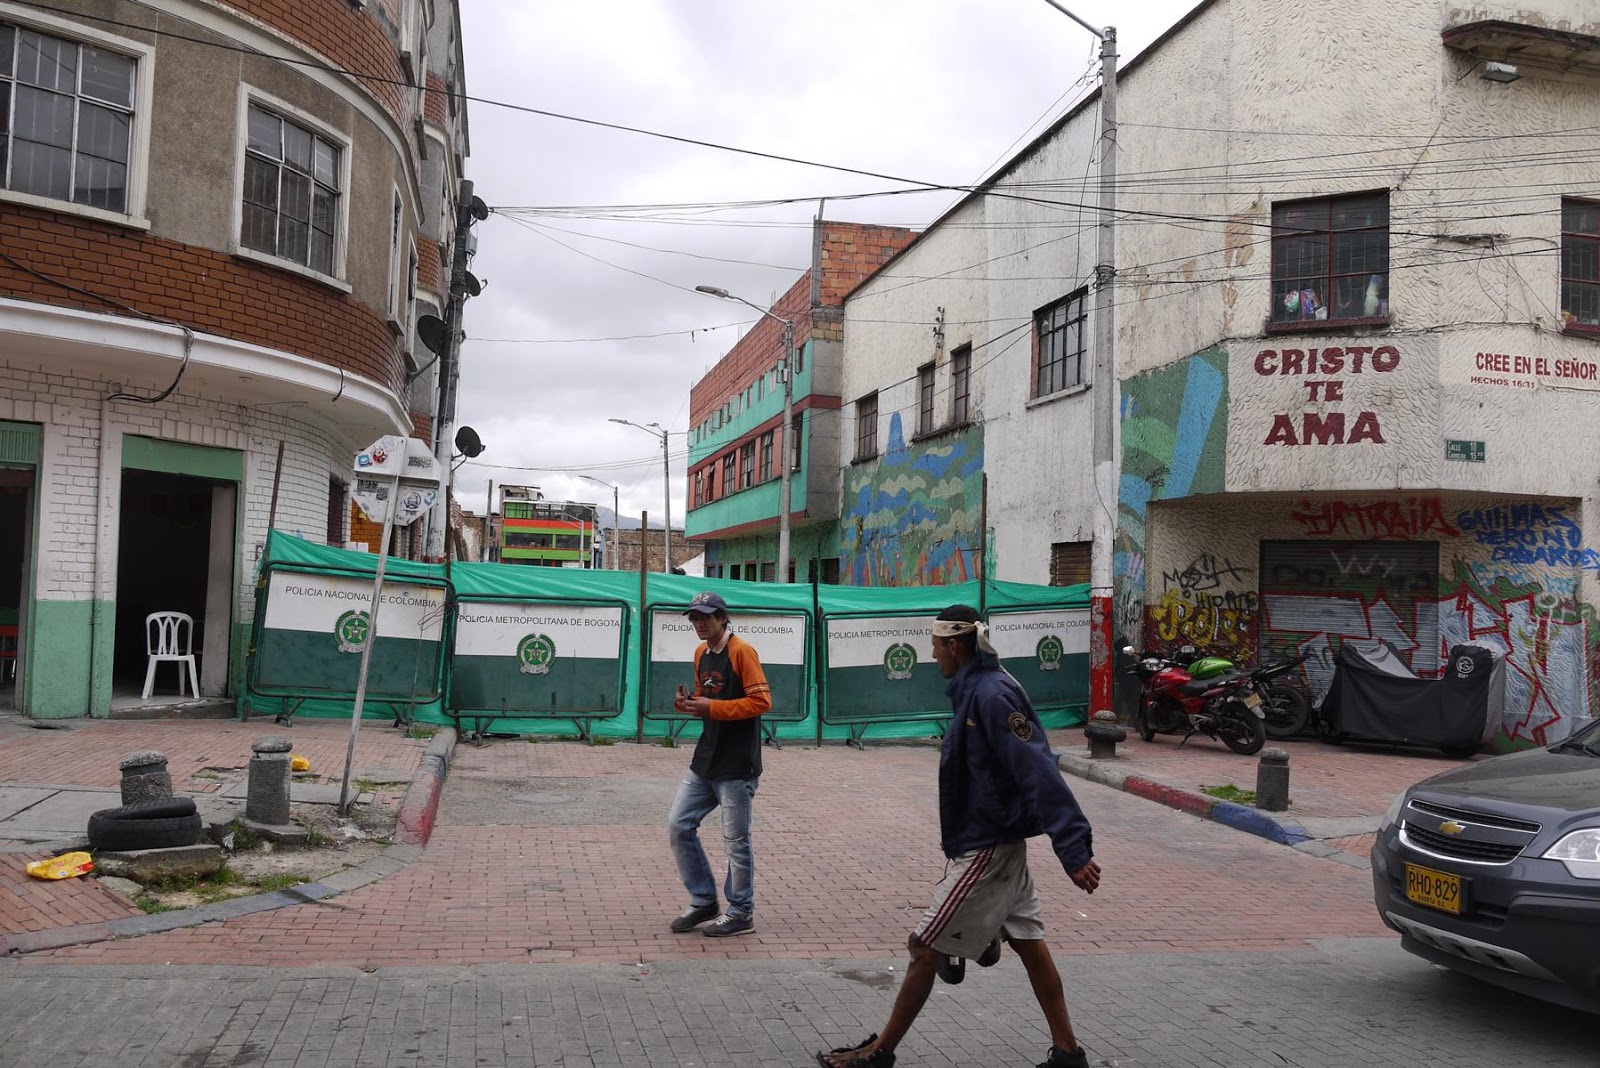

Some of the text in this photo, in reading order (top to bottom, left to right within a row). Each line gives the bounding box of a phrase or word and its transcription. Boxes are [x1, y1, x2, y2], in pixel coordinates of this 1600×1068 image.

[1254, 345, 1400, 376] CRISTO
[1475, 352, 1598, 380] CREE EN EL SEÑOR
[1470, 376, 1535, 389] HECHOS 16:31
[1304, 381, 1343, 402] TE
[1263, 411, 1387, 446] AMA
[285, 585, 323, 597] POLICIA
[324, 590, 371, 602] NACIONAL
[388, 596, 437, 608] COLOMBIA
[459, 615, 620, 627] POLICIA METROPOLITANA DE BOGOTA
[661, 623, 694, 632] POLICIA
[737, 625, 750, 633] DE
[750, 626, 794, 634] COLOMBIA
[995, 624, 1022, 632] POLICIA
[1022, 621, 1056, 630] NACIONAL
[828, 631, 860, 639] POLICIA
[860, 629, 924, 638] METROPOLITANA
